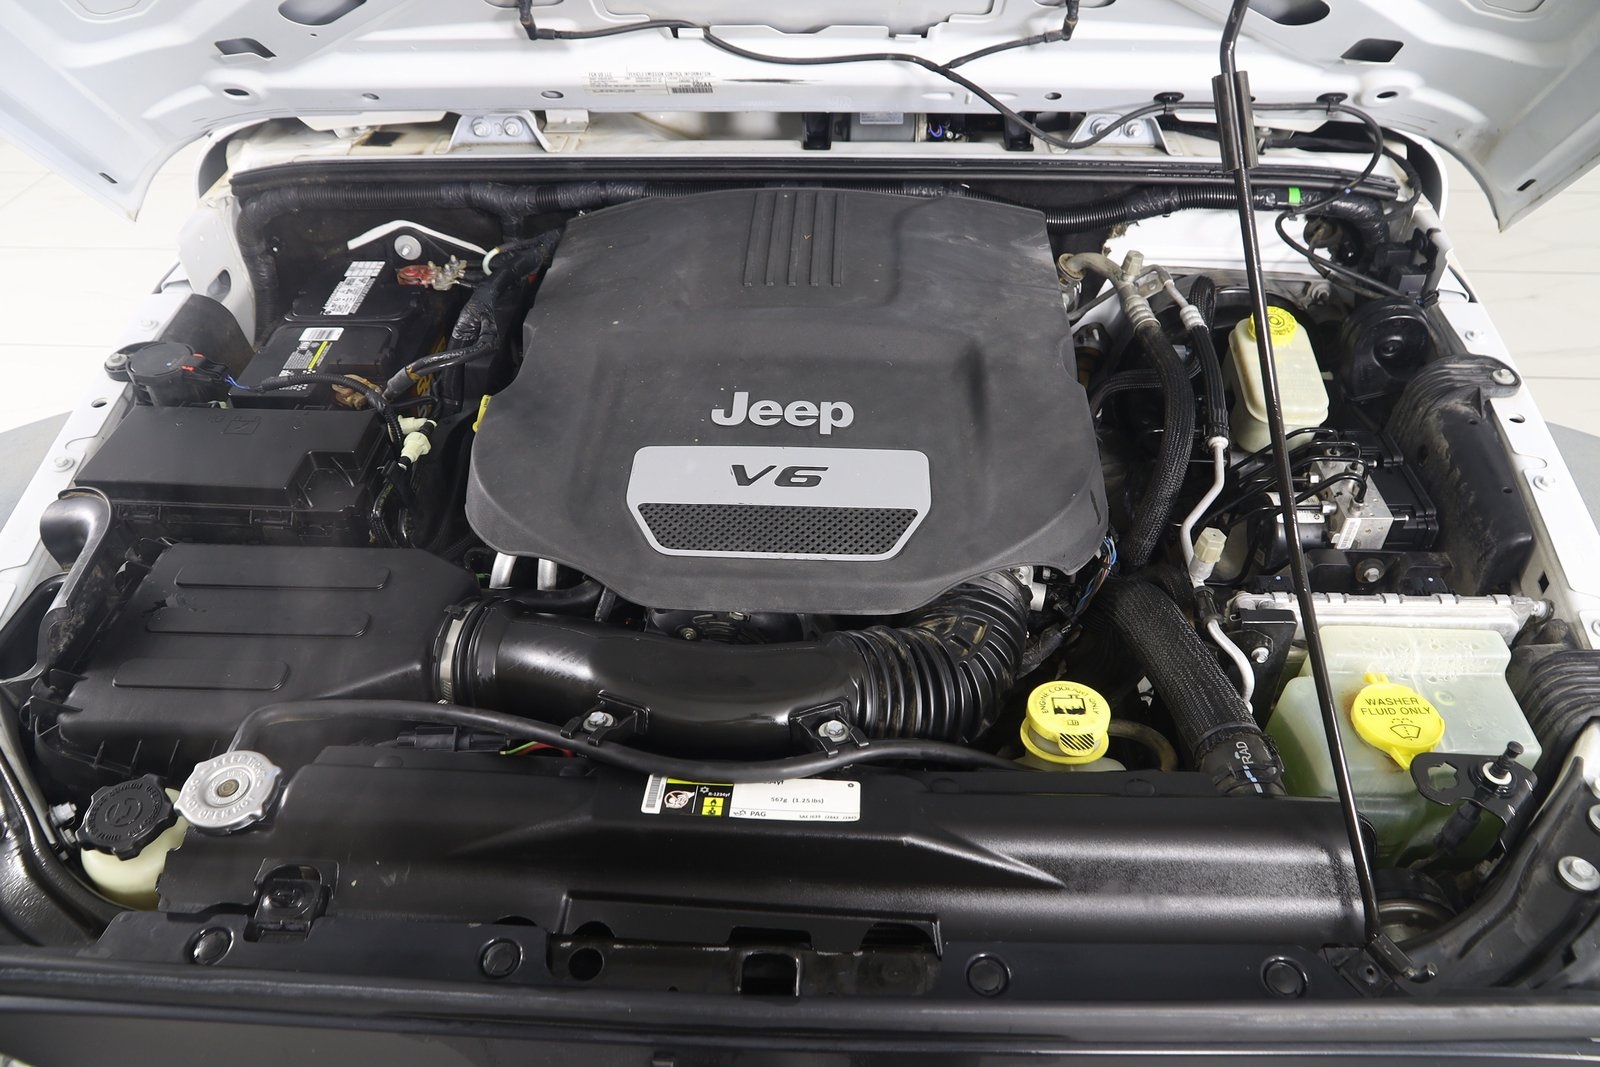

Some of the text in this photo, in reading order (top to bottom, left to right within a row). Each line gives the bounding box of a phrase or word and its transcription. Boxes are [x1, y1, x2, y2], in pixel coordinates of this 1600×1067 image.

[711, 391, 854, 435] Jeep
[731, 464, 829, 487] V6
[1039, 692, 1049, 714] ENGINE
[1361, 707, 1430, 715] FLUID ONLY
[1365, 697, 1419, 706] WASHER
[1235, 741, 1254, 765] RAD
